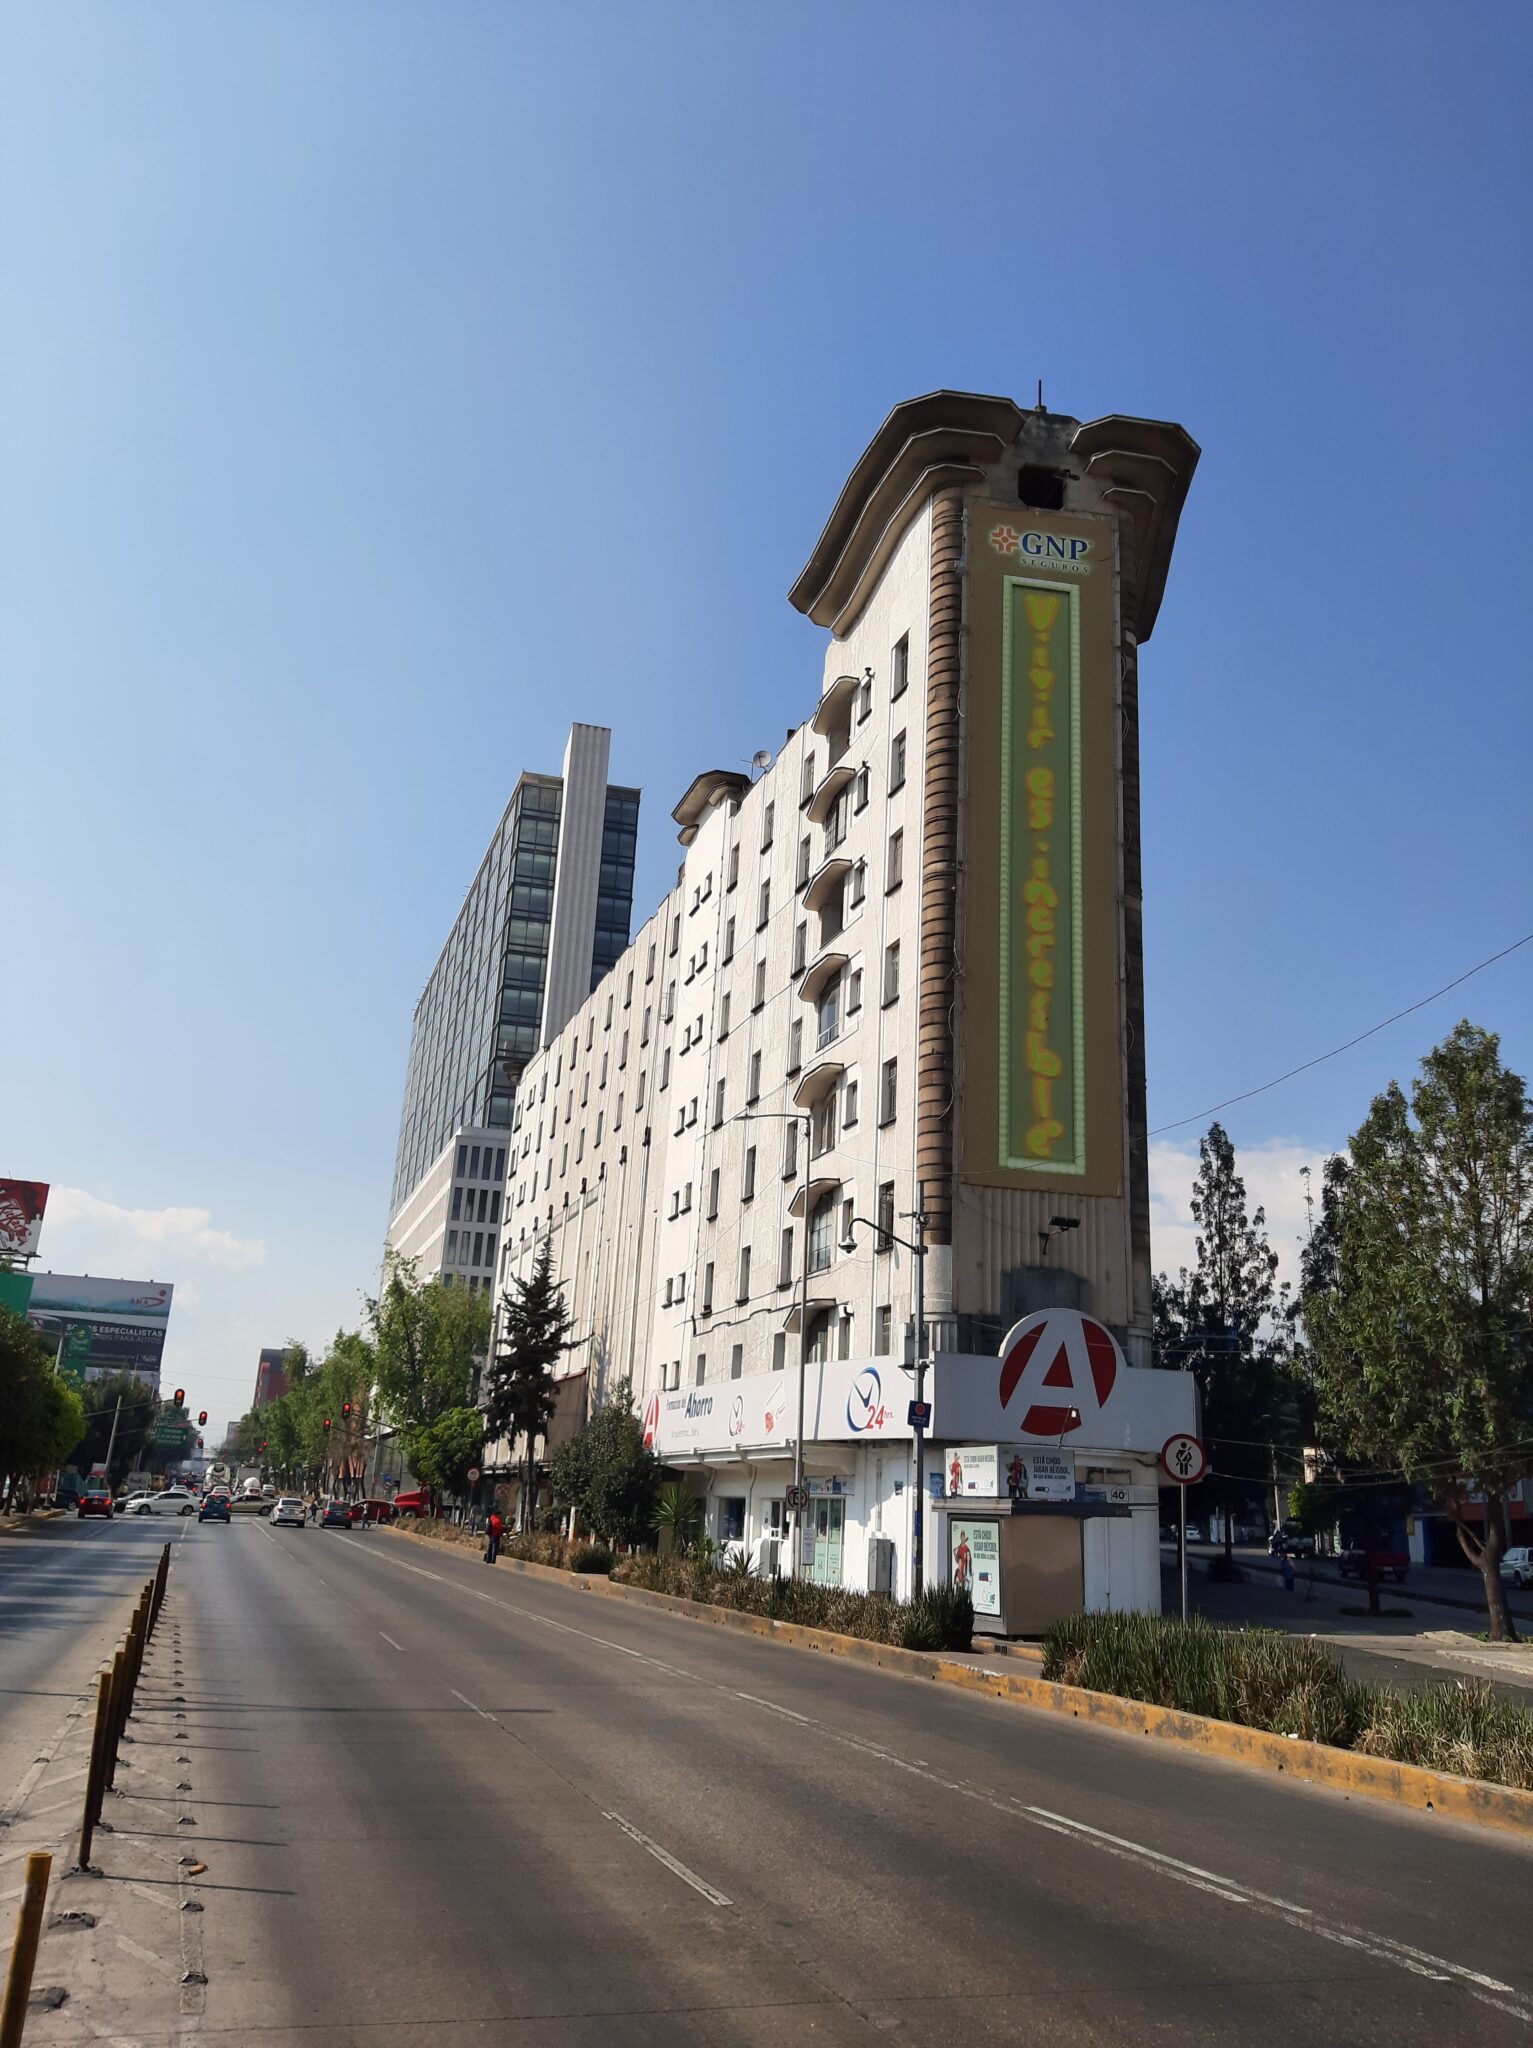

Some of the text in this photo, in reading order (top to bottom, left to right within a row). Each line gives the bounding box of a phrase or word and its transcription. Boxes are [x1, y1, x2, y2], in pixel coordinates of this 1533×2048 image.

[1021, 532, 1088, 560] GNP
[1021, 558, 1089, 573] SEGUROS
[1026, 767, 1055, 831] es
[99, 1326, 163, 1337] ESPECIALISTAS
[684, 1392, 713, 1419] Ahorro
